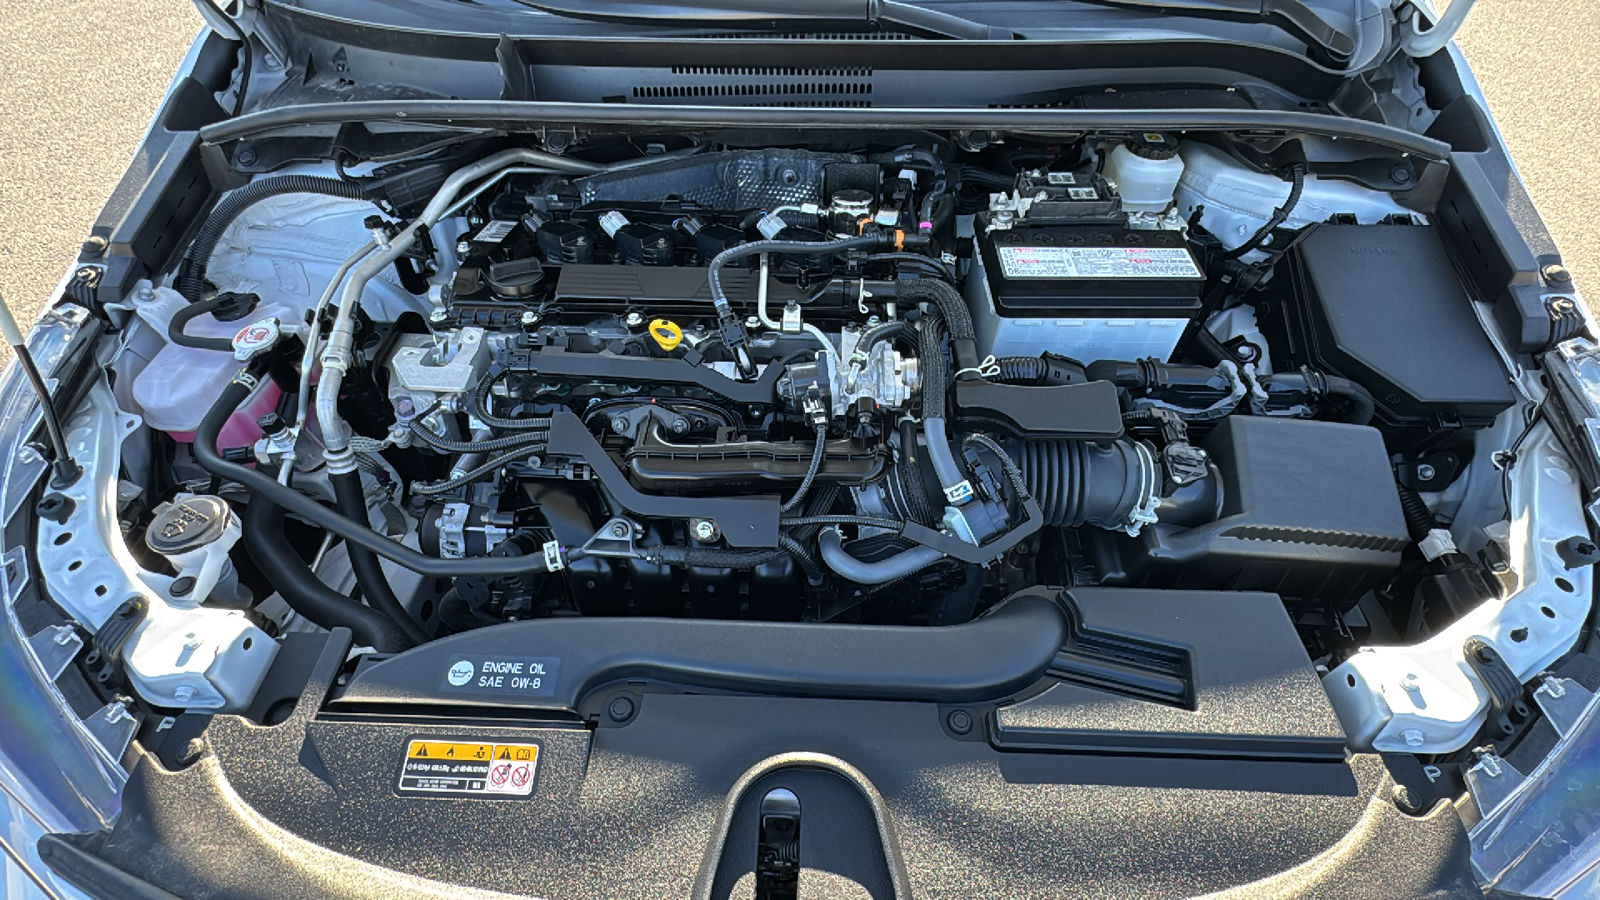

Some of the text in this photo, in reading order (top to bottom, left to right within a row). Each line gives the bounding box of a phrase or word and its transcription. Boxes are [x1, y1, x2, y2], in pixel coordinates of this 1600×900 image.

[482, 661, 546, 675] ENGINE OIL
[478, 676, 504, 687] SAE
